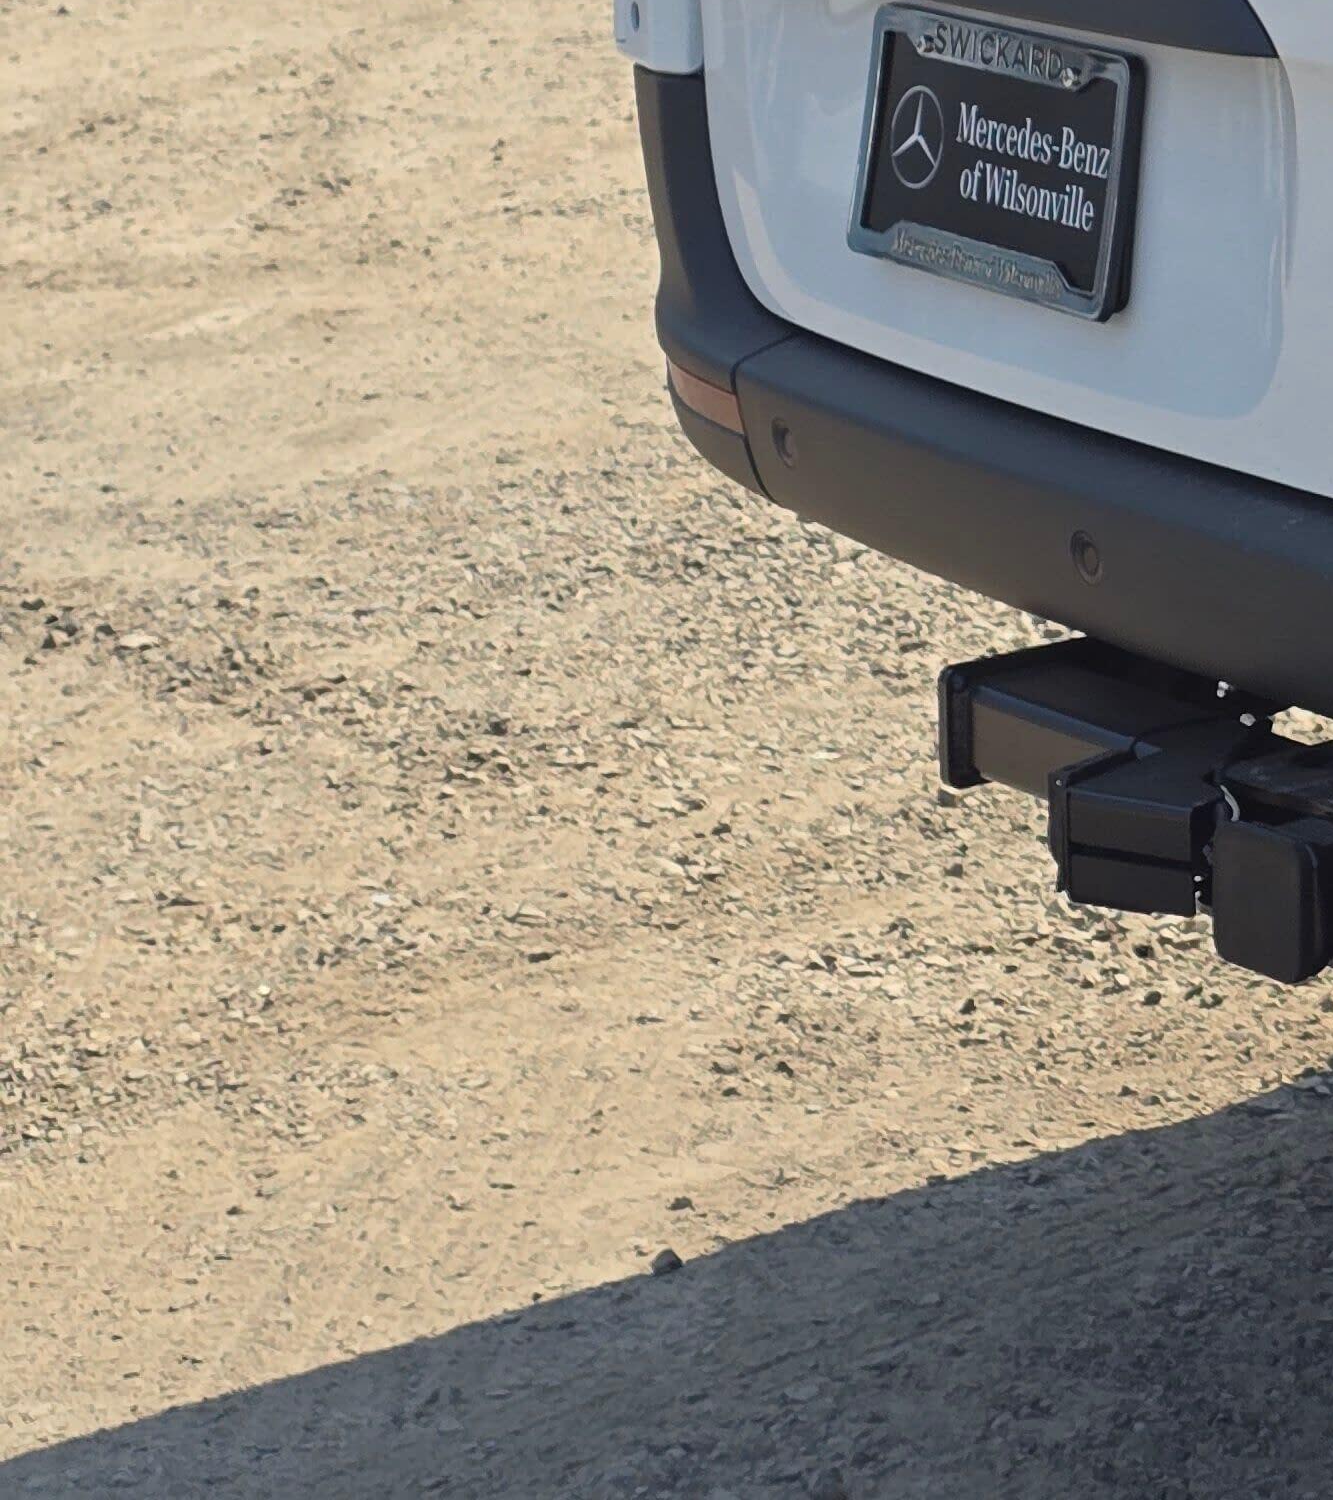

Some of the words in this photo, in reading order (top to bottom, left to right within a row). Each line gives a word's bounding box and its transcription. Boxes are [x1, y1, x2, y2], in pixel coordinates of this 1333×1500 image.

[935, 22, 1064, 79] SWICKARD
[955, 102, 1111, 180] Mercedes-Benz
[959, 159, 983, 202] of
[985, 162, 1095, 232] Wilsonville
